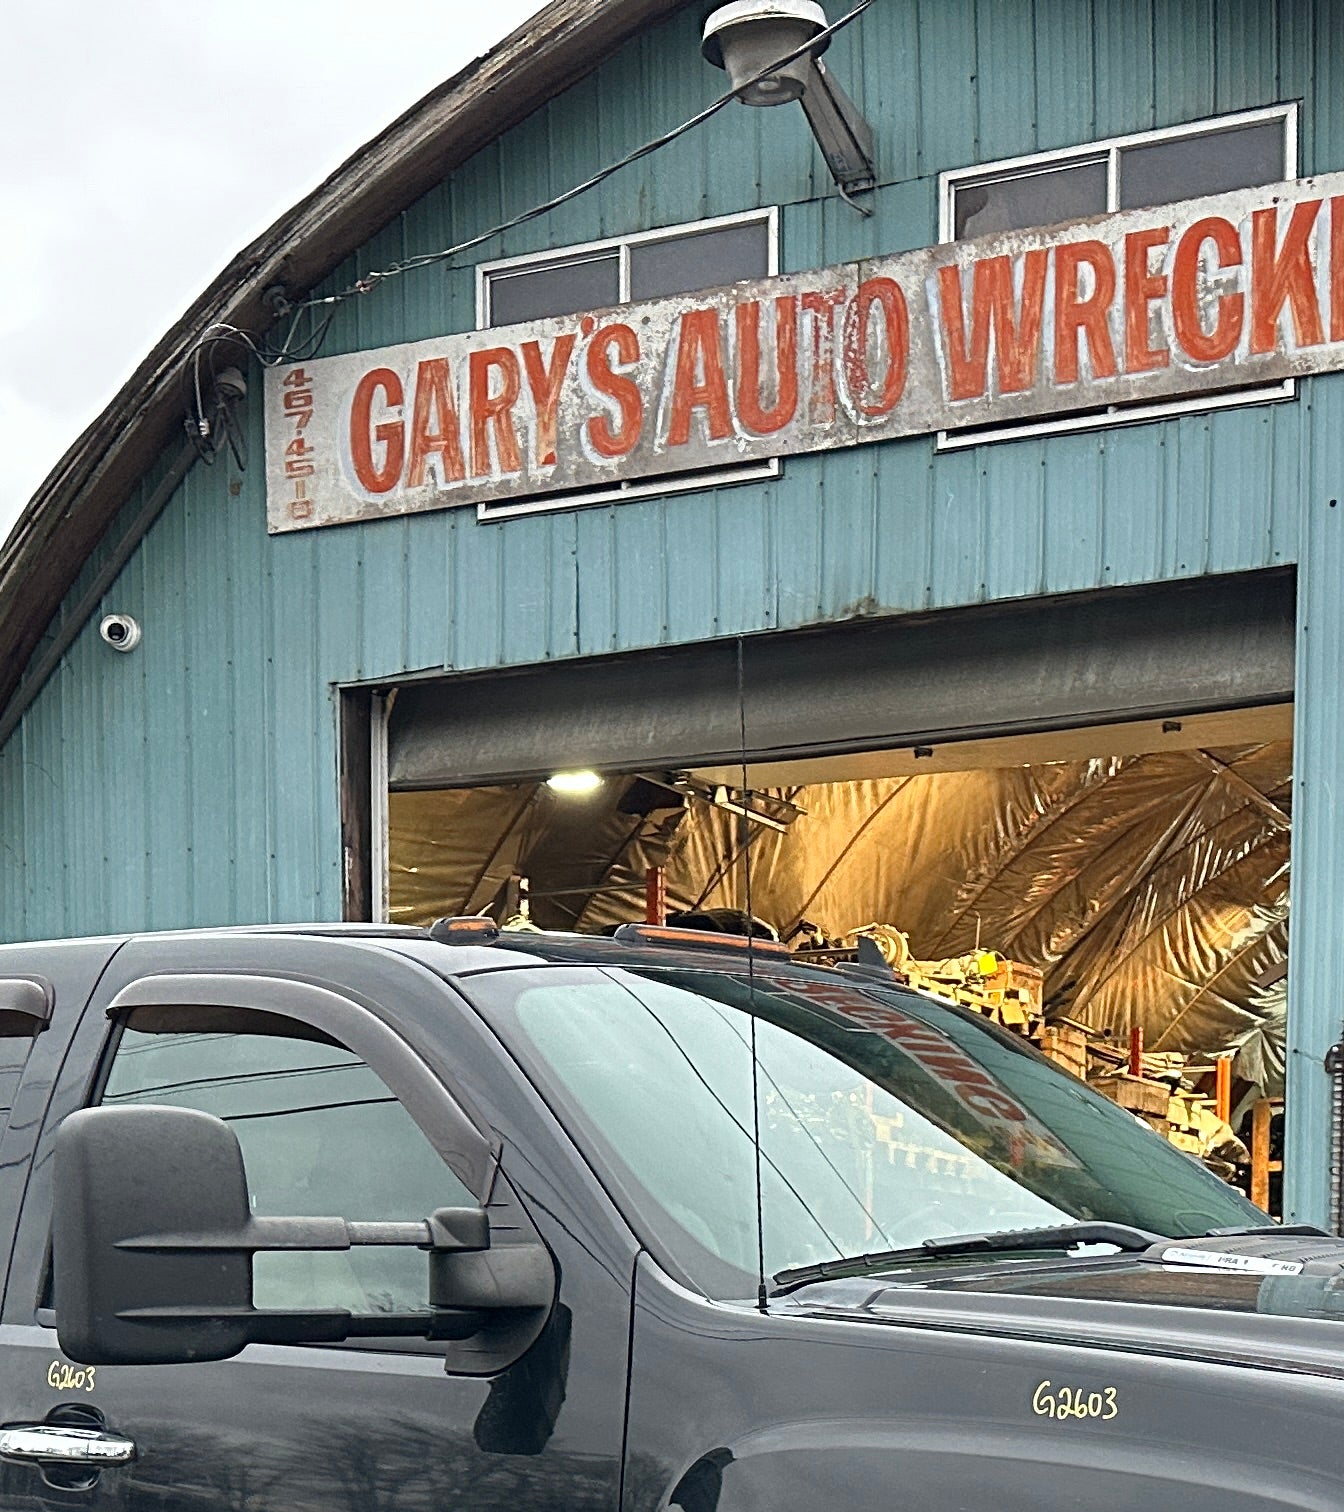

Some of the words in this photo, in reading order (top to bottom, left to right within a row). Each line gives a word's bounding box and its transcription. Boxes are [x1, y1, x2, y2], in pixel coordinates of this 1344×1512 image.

[350, 315, 644, 495] GARY'S
[667, 275, 909, 447] AUTO
[47, 1360, 96, 1392] G2603
[1032, 1380, 1119, 1420] G2603
